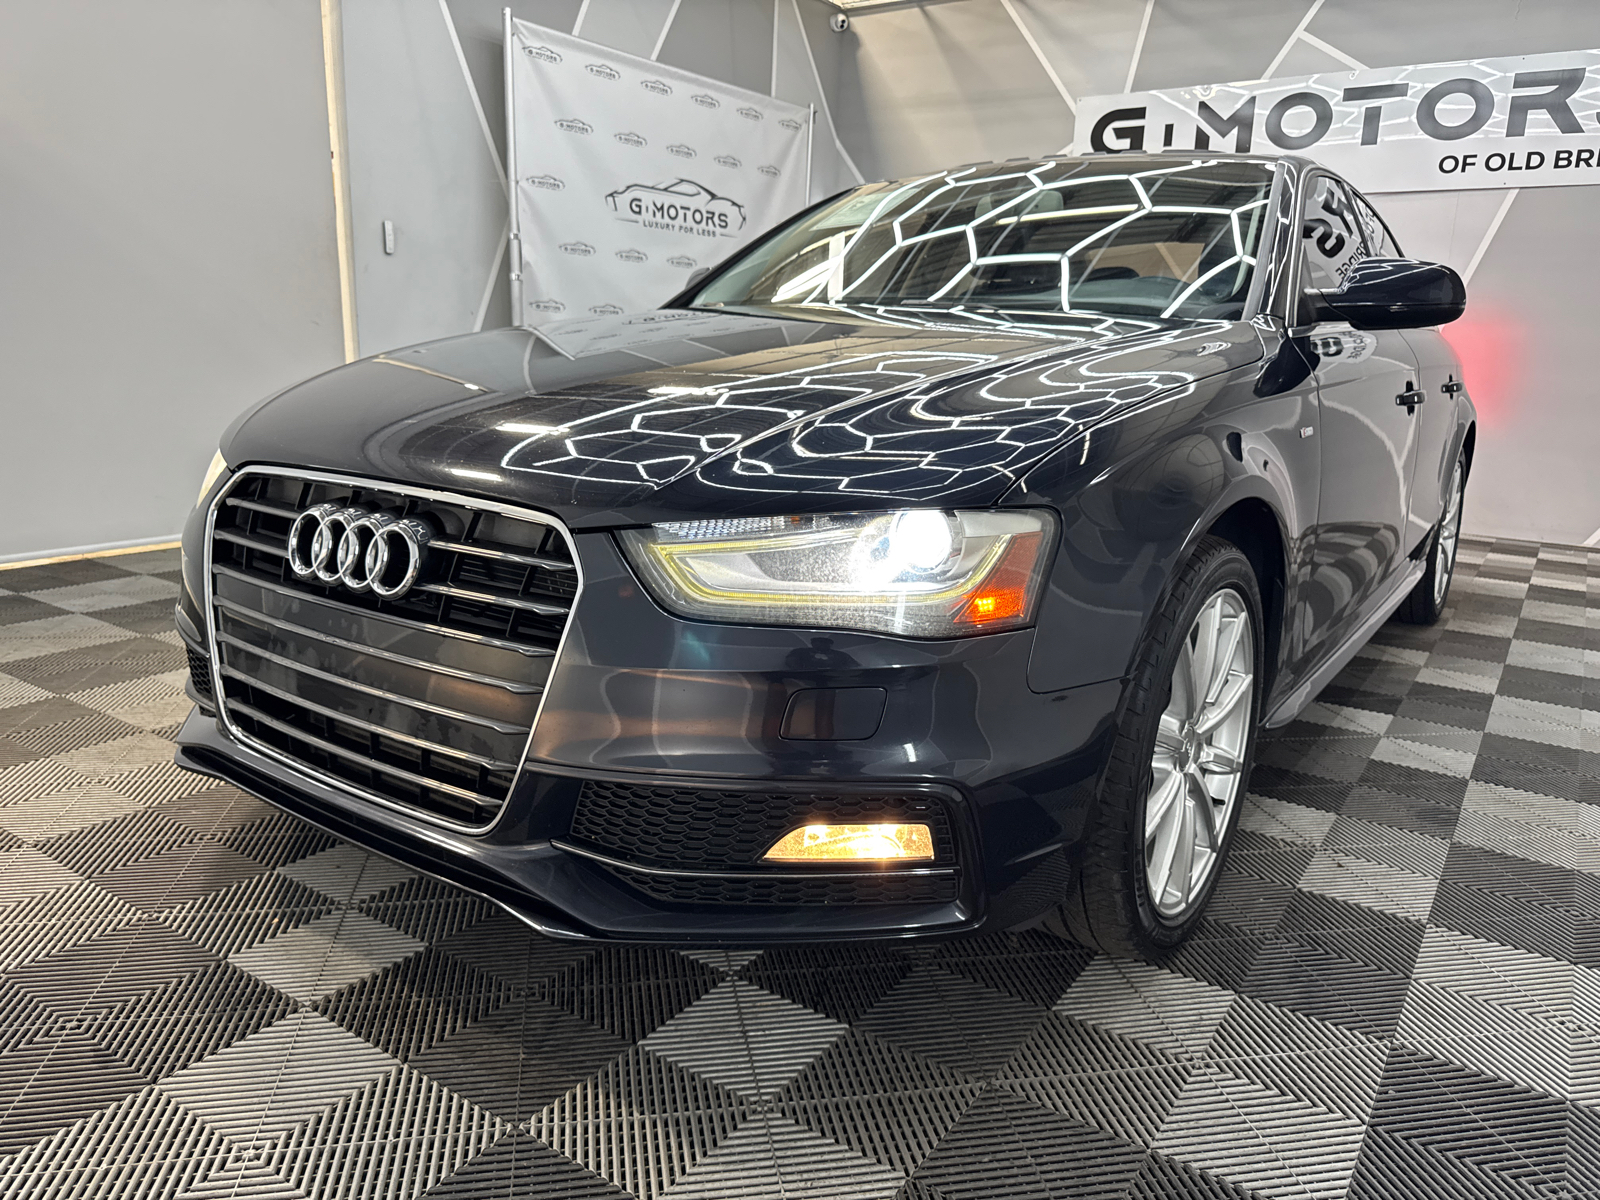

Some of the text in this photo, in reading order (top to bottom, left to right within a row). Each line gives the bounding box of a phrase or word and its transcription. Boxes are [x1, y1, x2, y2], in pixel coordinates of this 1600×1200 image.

[1090, 67, 1600, 153] G MOTOR
[1437, 152, 1479, 174] OF
[1484, 150, 1545, 172] OLD
[629, 197, 729, 229] G MOTORS
[642, 220, 717, 238] LUXURY FOR LESS
